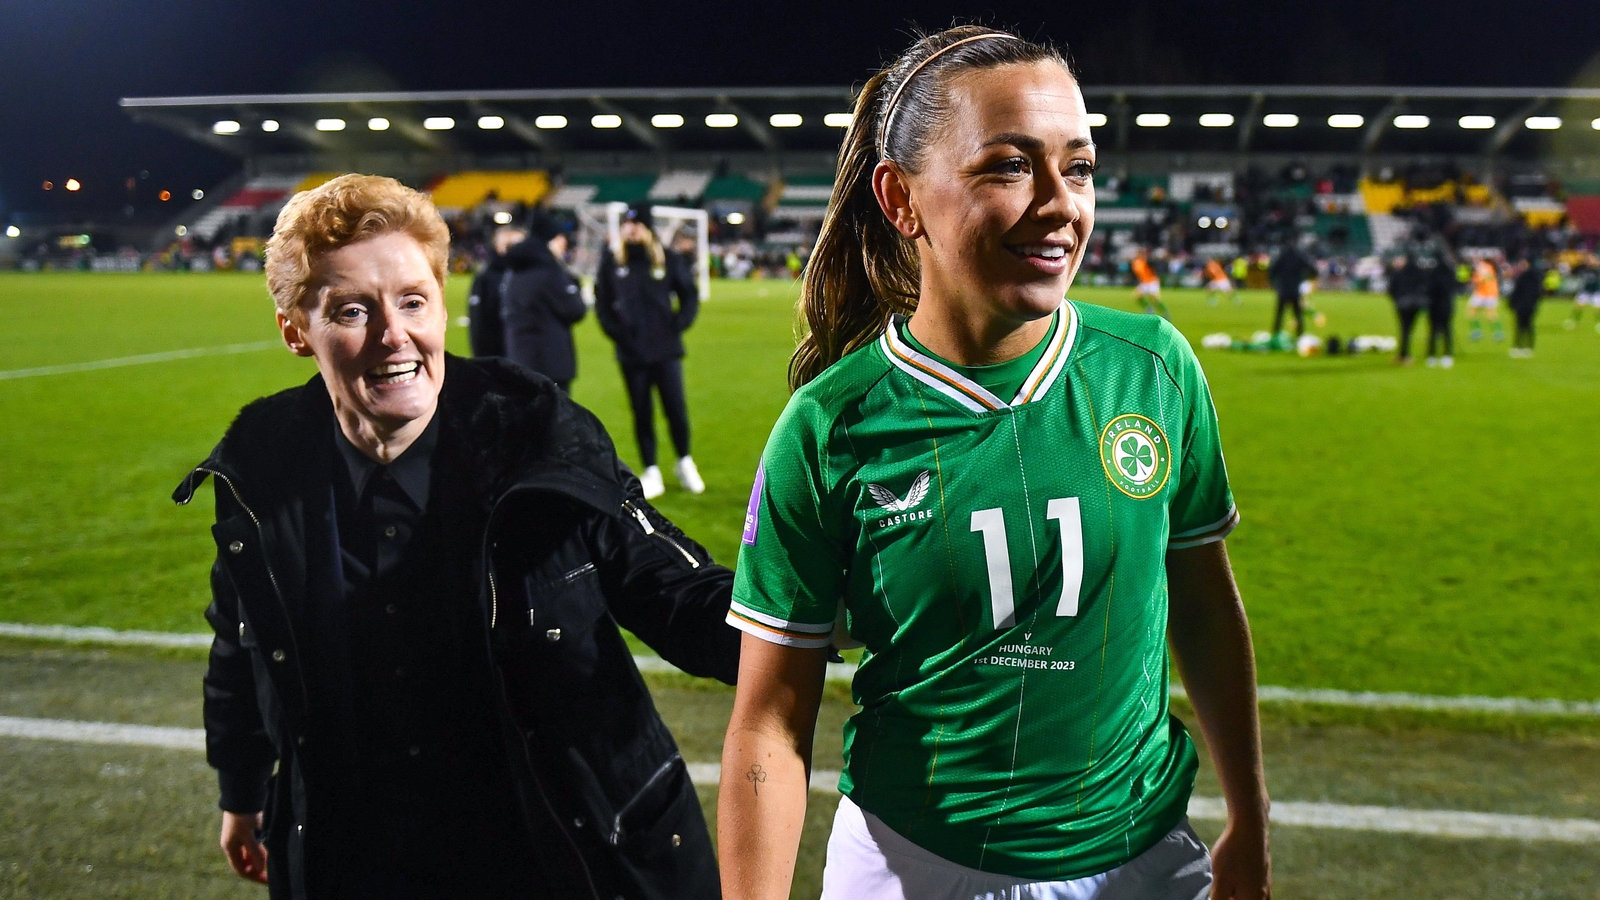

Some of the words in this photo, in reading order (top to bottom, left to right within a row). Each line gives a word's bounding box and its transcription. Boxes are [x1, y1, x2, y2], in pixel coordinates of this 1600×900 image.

[1105, 420, 1161, 445] IRELAND
[1120, 480, 1159, 493] FOOTBALL
[878, 509, 933, 528] CASTORE
[970, 496, 1084, 631] 11
[999, 645, 1053, 656] HUNGARY
[990, 656, 1048, 669] DECEMBER
[1050, 661, 1075, 670] 2023
